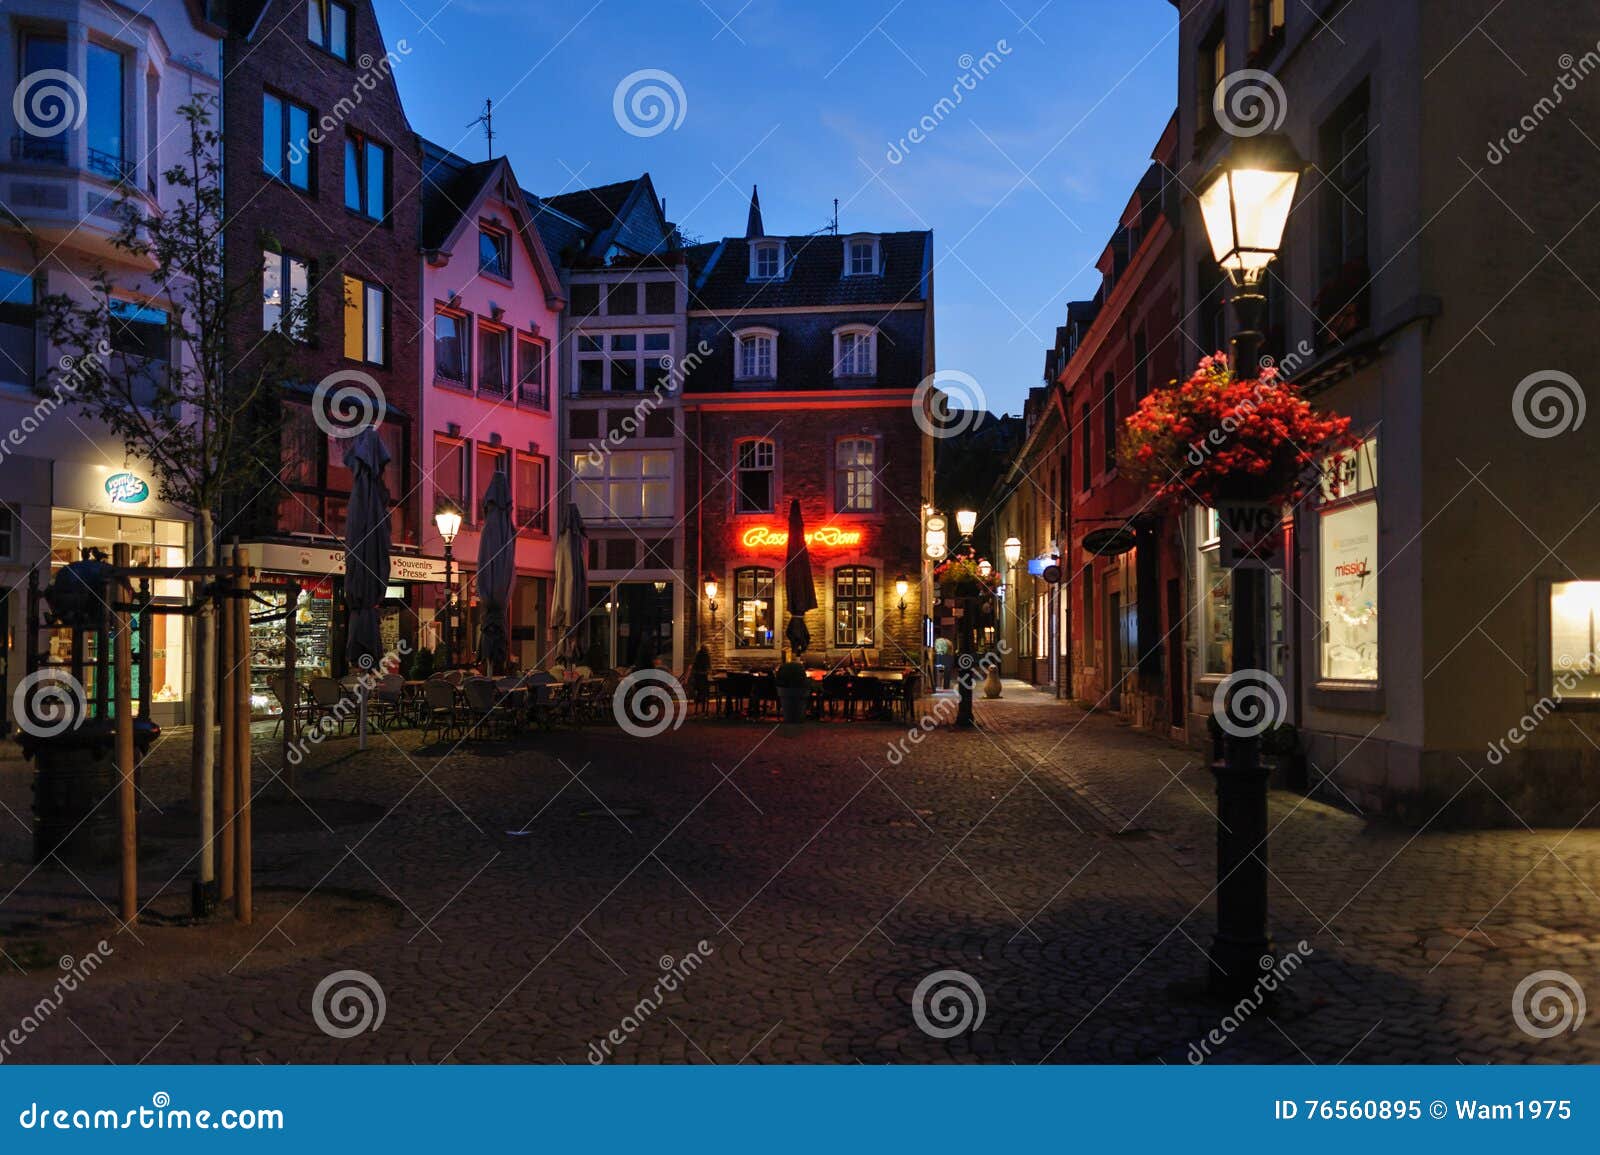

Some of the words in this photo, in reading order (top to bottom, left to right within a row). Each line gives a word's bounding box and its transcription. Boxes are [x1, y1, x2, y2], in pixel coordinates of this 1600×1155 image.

[108, 476, 129, 490] vom
[109, 479, 144, 502] FASS
[814, 527, 860, 546] Dom
[397, 559, 433, 570] Souvenirs
[402, 568, 427, 579] Presse
